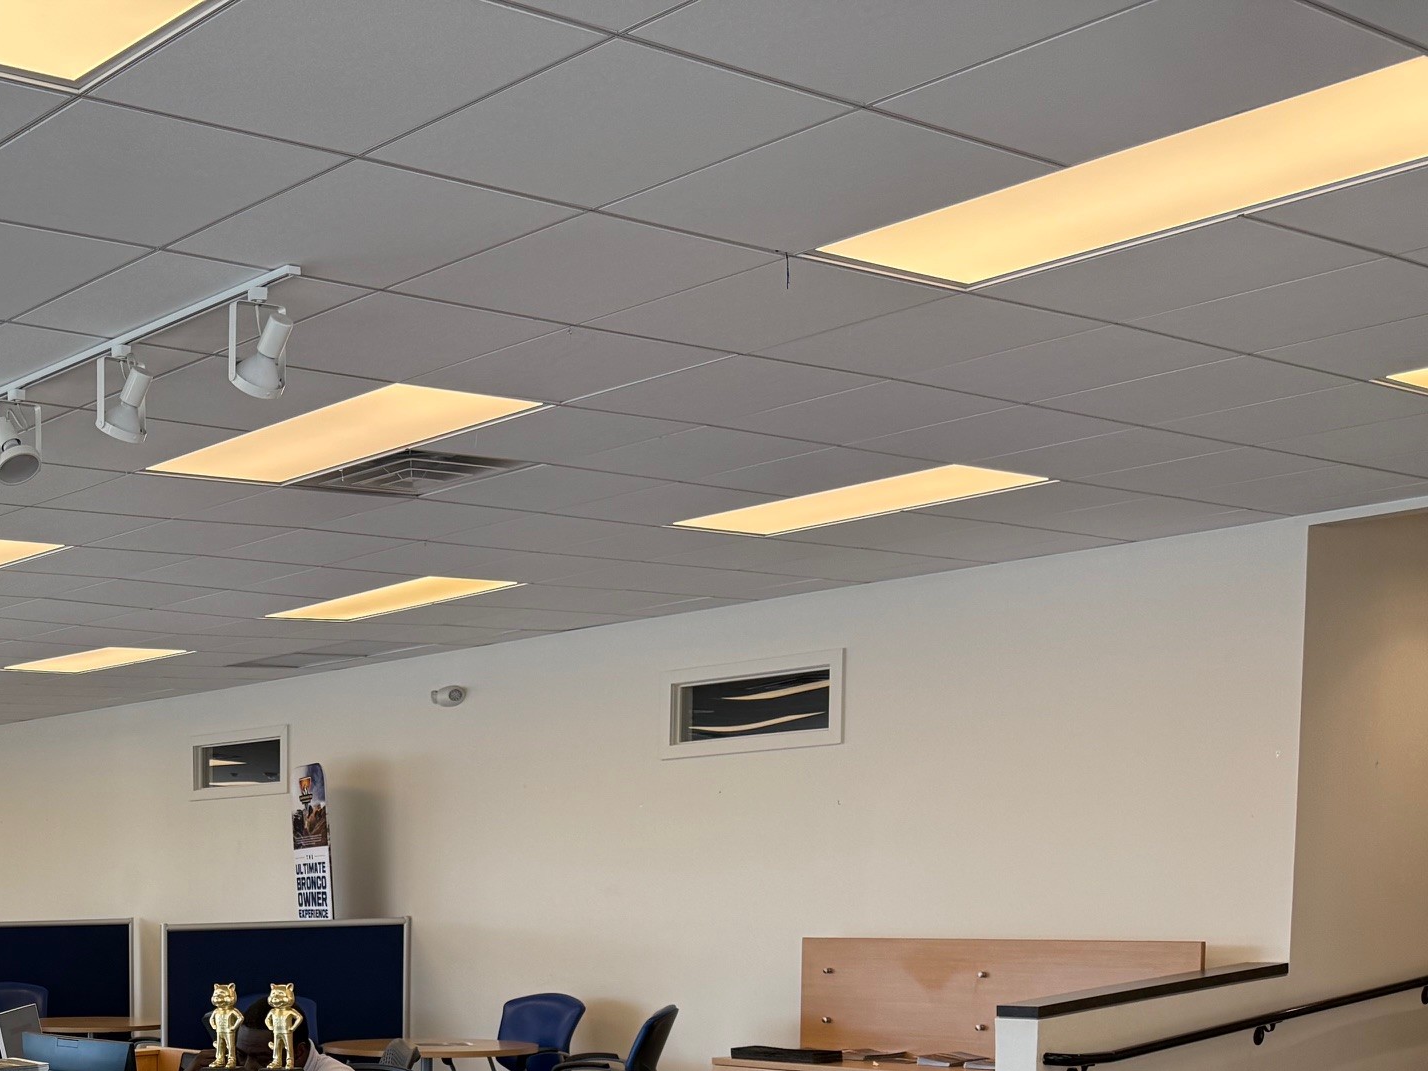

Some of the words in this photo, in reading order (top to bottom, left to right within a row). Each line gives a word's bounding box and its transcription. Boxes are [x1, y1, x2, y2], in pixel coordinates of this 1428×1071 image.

[296, 862, 326, 875] ULTIMATE
[297, 876, 326, 890] BRONCO
[298, 892, 327, 907] OWNER
[299, 909, 328, 918] EXPERIENCE
